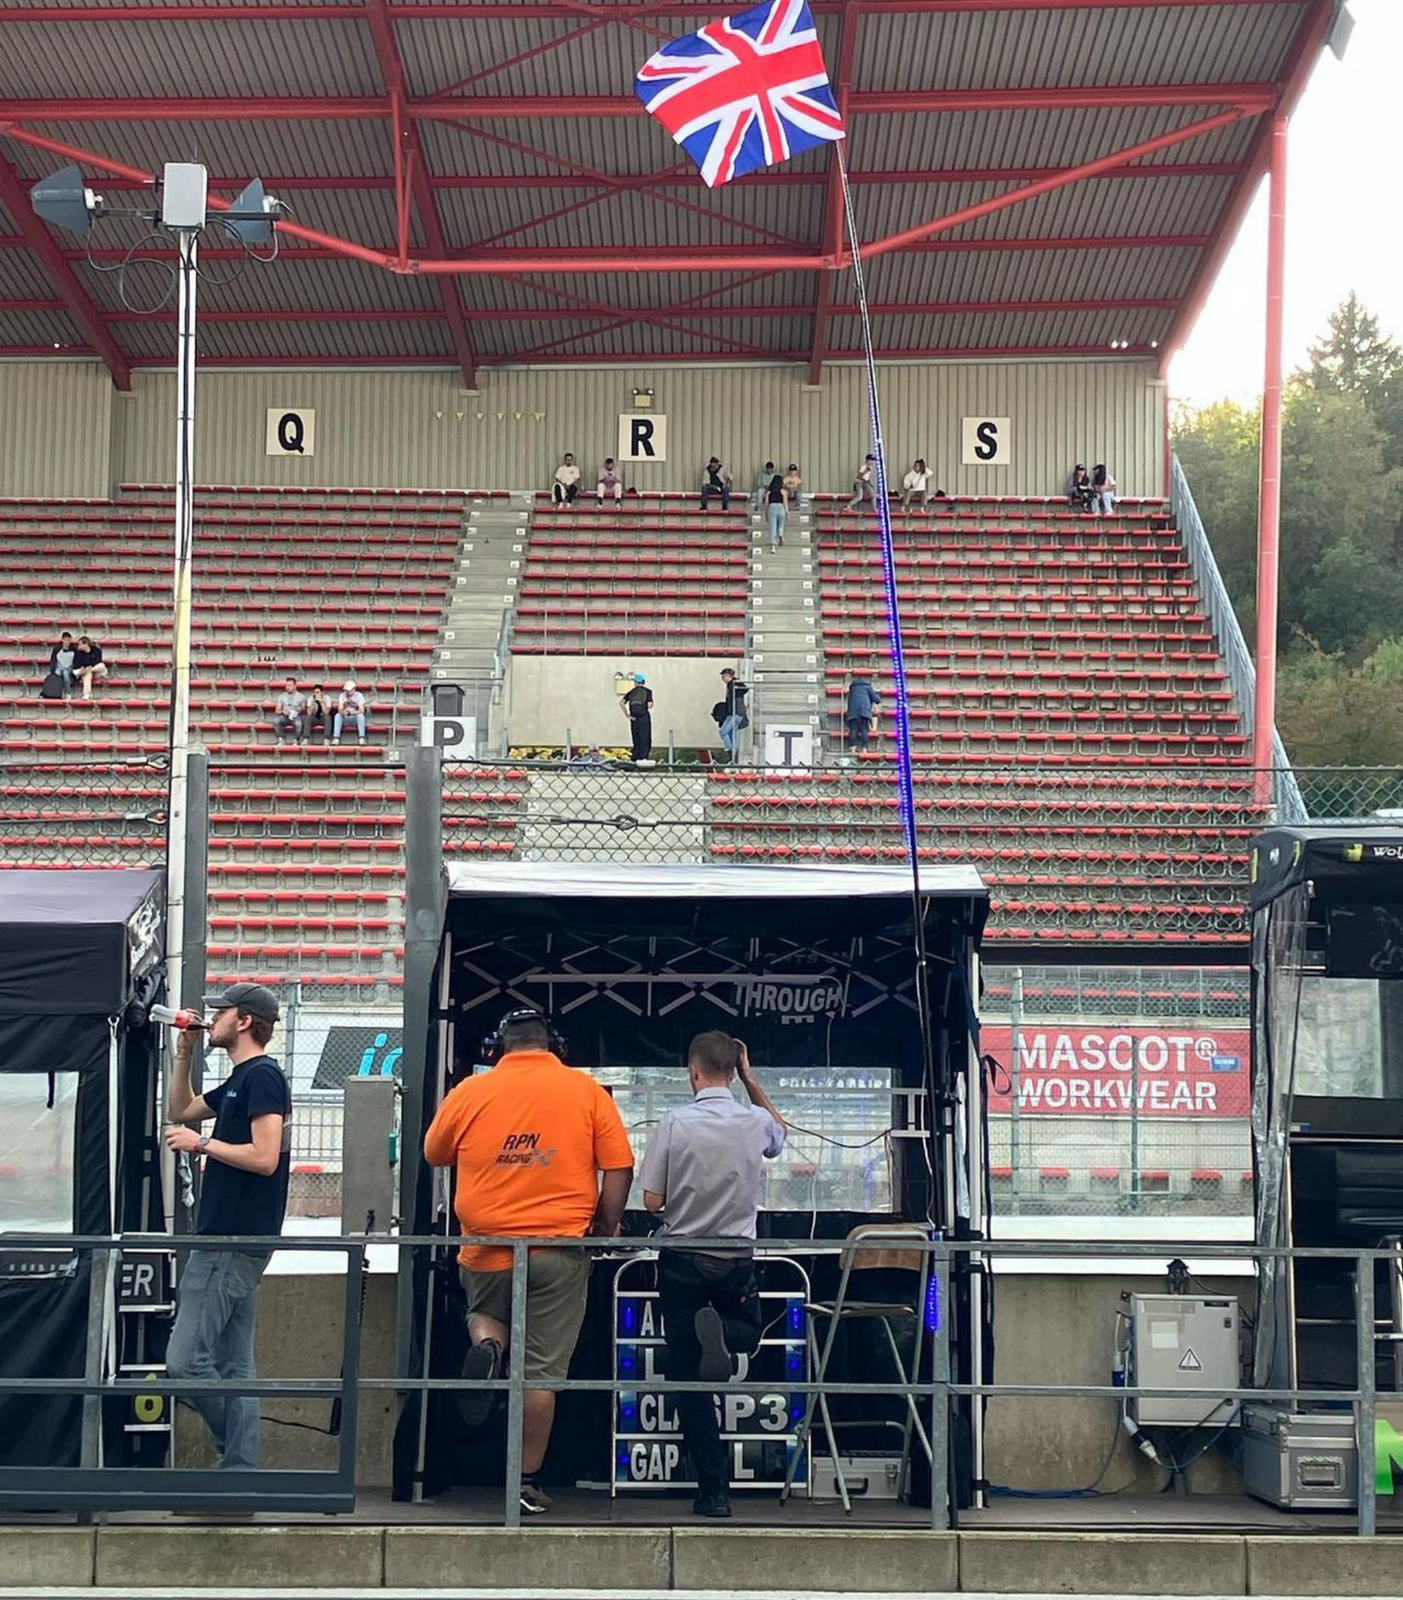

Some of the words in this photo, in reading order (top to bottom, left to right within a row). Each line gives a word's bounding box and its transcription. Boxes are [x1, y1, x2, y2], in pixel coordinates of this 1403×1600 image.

[278, 413, 304, 454] Q
[631, 419, 655, 456] R
[974, 422, 998, 460] S
[434, 720, 464, 759] P
[774, 731, 803, 766] T
[734, 981, 841, 1013] THROUGH
[1017, 1078, 1218, 1110] WORKWEAR
[495, 1152, 533, 1165] RACING
[503, 1133, 541, 1150] RPN
[630, 1442, 679, 1480] GAP
[734, 1442, 755, 1479] L
